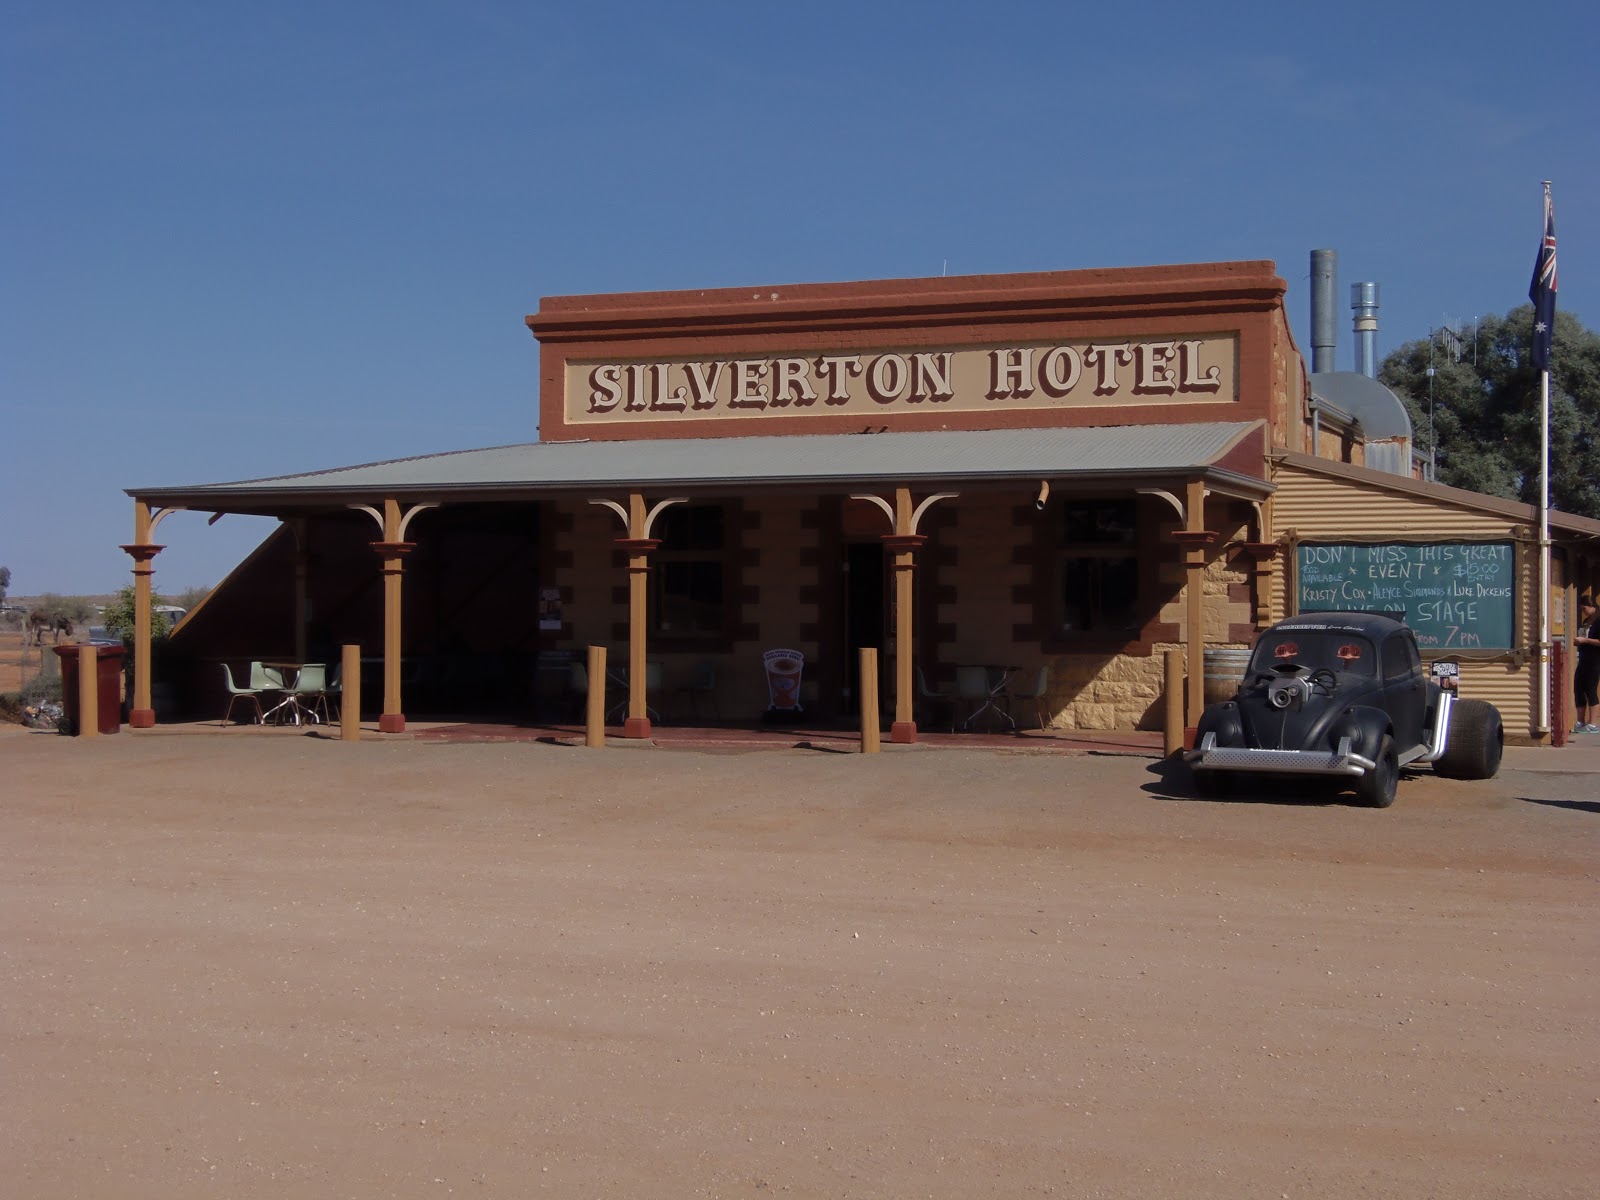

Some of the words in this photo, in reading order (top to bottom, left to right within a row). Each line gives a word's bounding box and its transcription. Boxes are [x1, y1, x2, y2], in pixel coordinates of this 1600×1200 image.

[586, 352, 955, 413] SILVERTON
[985, 340, 1221, 400] HOTEL
[1304, 546, 1356, 564] DON'T
[1367, 546, 1408, 563] MISS
[1415, 546, 1454, 561] THIS
[1460, 545, 1510, 564] GREAT
[1302, 573, 1343, 583] AVAILABLE
[1368, 562, 1426, 580] EVENT
[1467, 574, 1495, 582] ENTRY
[1417, 600, 1477, 624] STAGE
[1445, 625, 1459, 647] 7
[1460, 632, 1480, 647] PM
